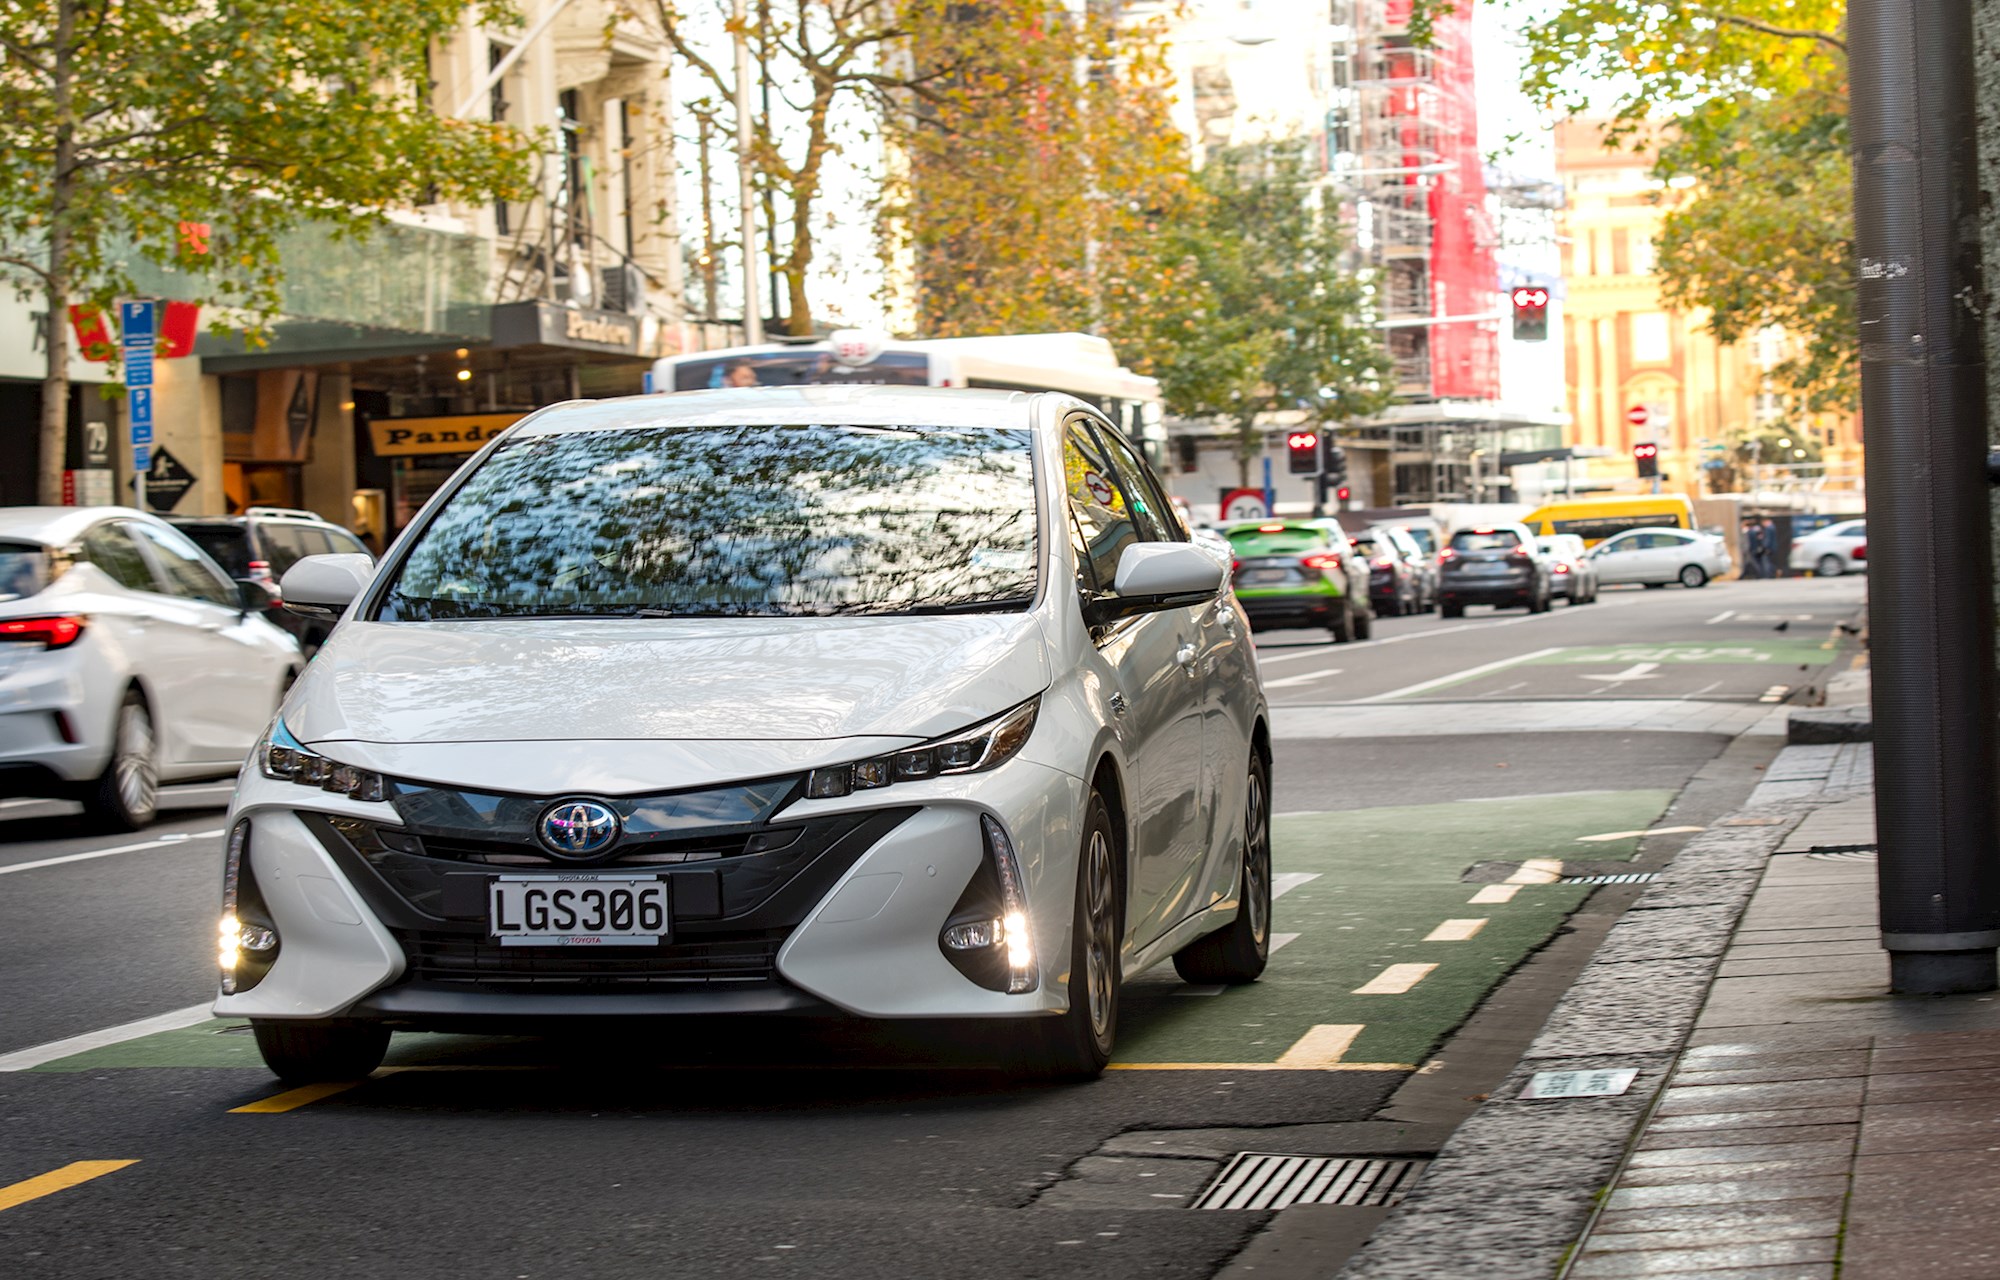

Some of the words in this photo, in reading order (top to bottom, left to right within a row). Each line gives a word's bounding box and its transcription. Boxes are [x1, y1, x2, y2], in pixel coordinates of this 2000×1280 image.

[131, 303, 145, 318] P
[86, 421, 108, 452] 79
[1233, 505, 1261, 518] 30
[496, 888, 663, 931] LGS306
[570, 936, 602, 944] TOYOTA
